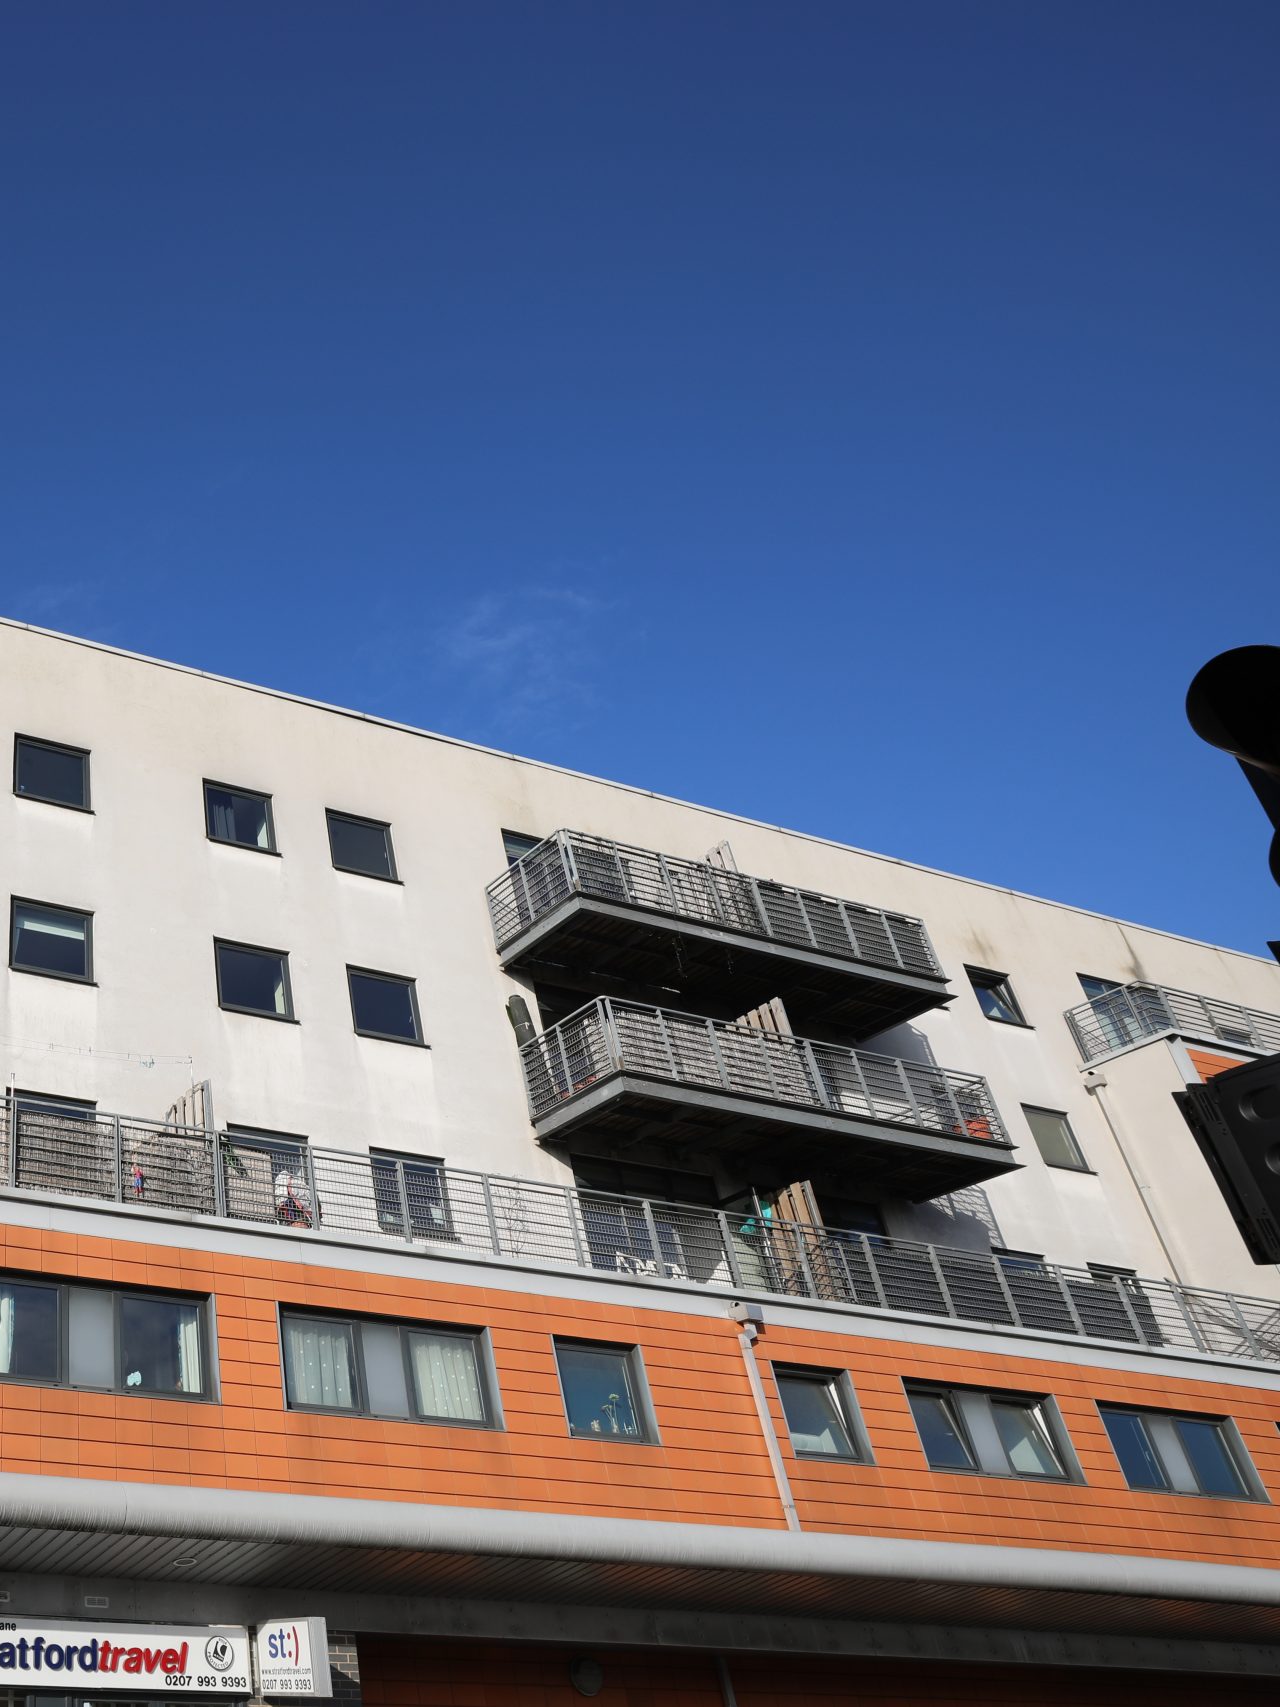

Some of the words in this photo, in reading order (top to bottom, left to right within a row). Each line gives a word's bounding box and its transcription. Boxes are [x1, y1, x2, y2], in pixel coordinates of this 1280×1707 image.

[165, 1675, 193, 1686] 0207
[197, 1676, 217, 1687] 993
[221, 1676, 247, 1688] 9393
[261, 1679, 277, 1690] 0207
[279, 1679, 293, 1690] 993
[294, 1679, 312, 1690] 9393
